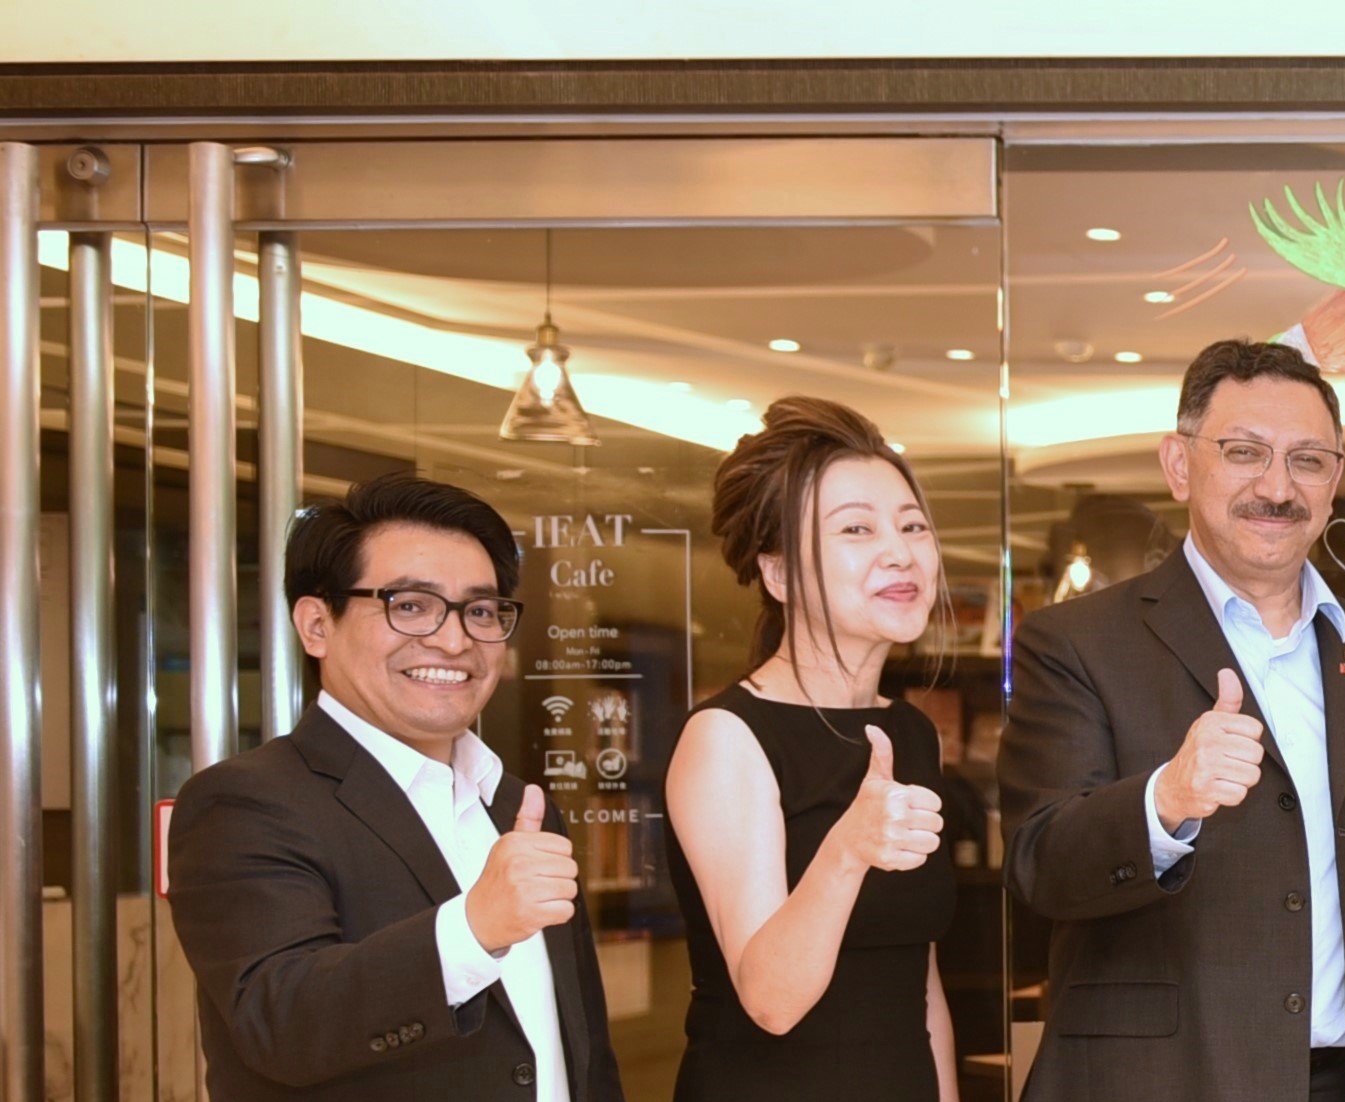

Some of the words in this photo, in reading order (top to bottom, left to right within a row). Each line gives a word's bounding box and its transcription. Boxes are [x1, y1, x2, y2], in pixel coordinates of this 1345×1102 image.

[532, 513, 633, 548] IEAT
[550, 559, 615, 588] Cafe
[547, 625, 586, 641] Open
[588, 624, 619, 638] time
[535, 659, 632, 671] 08:00am-17:00pm
